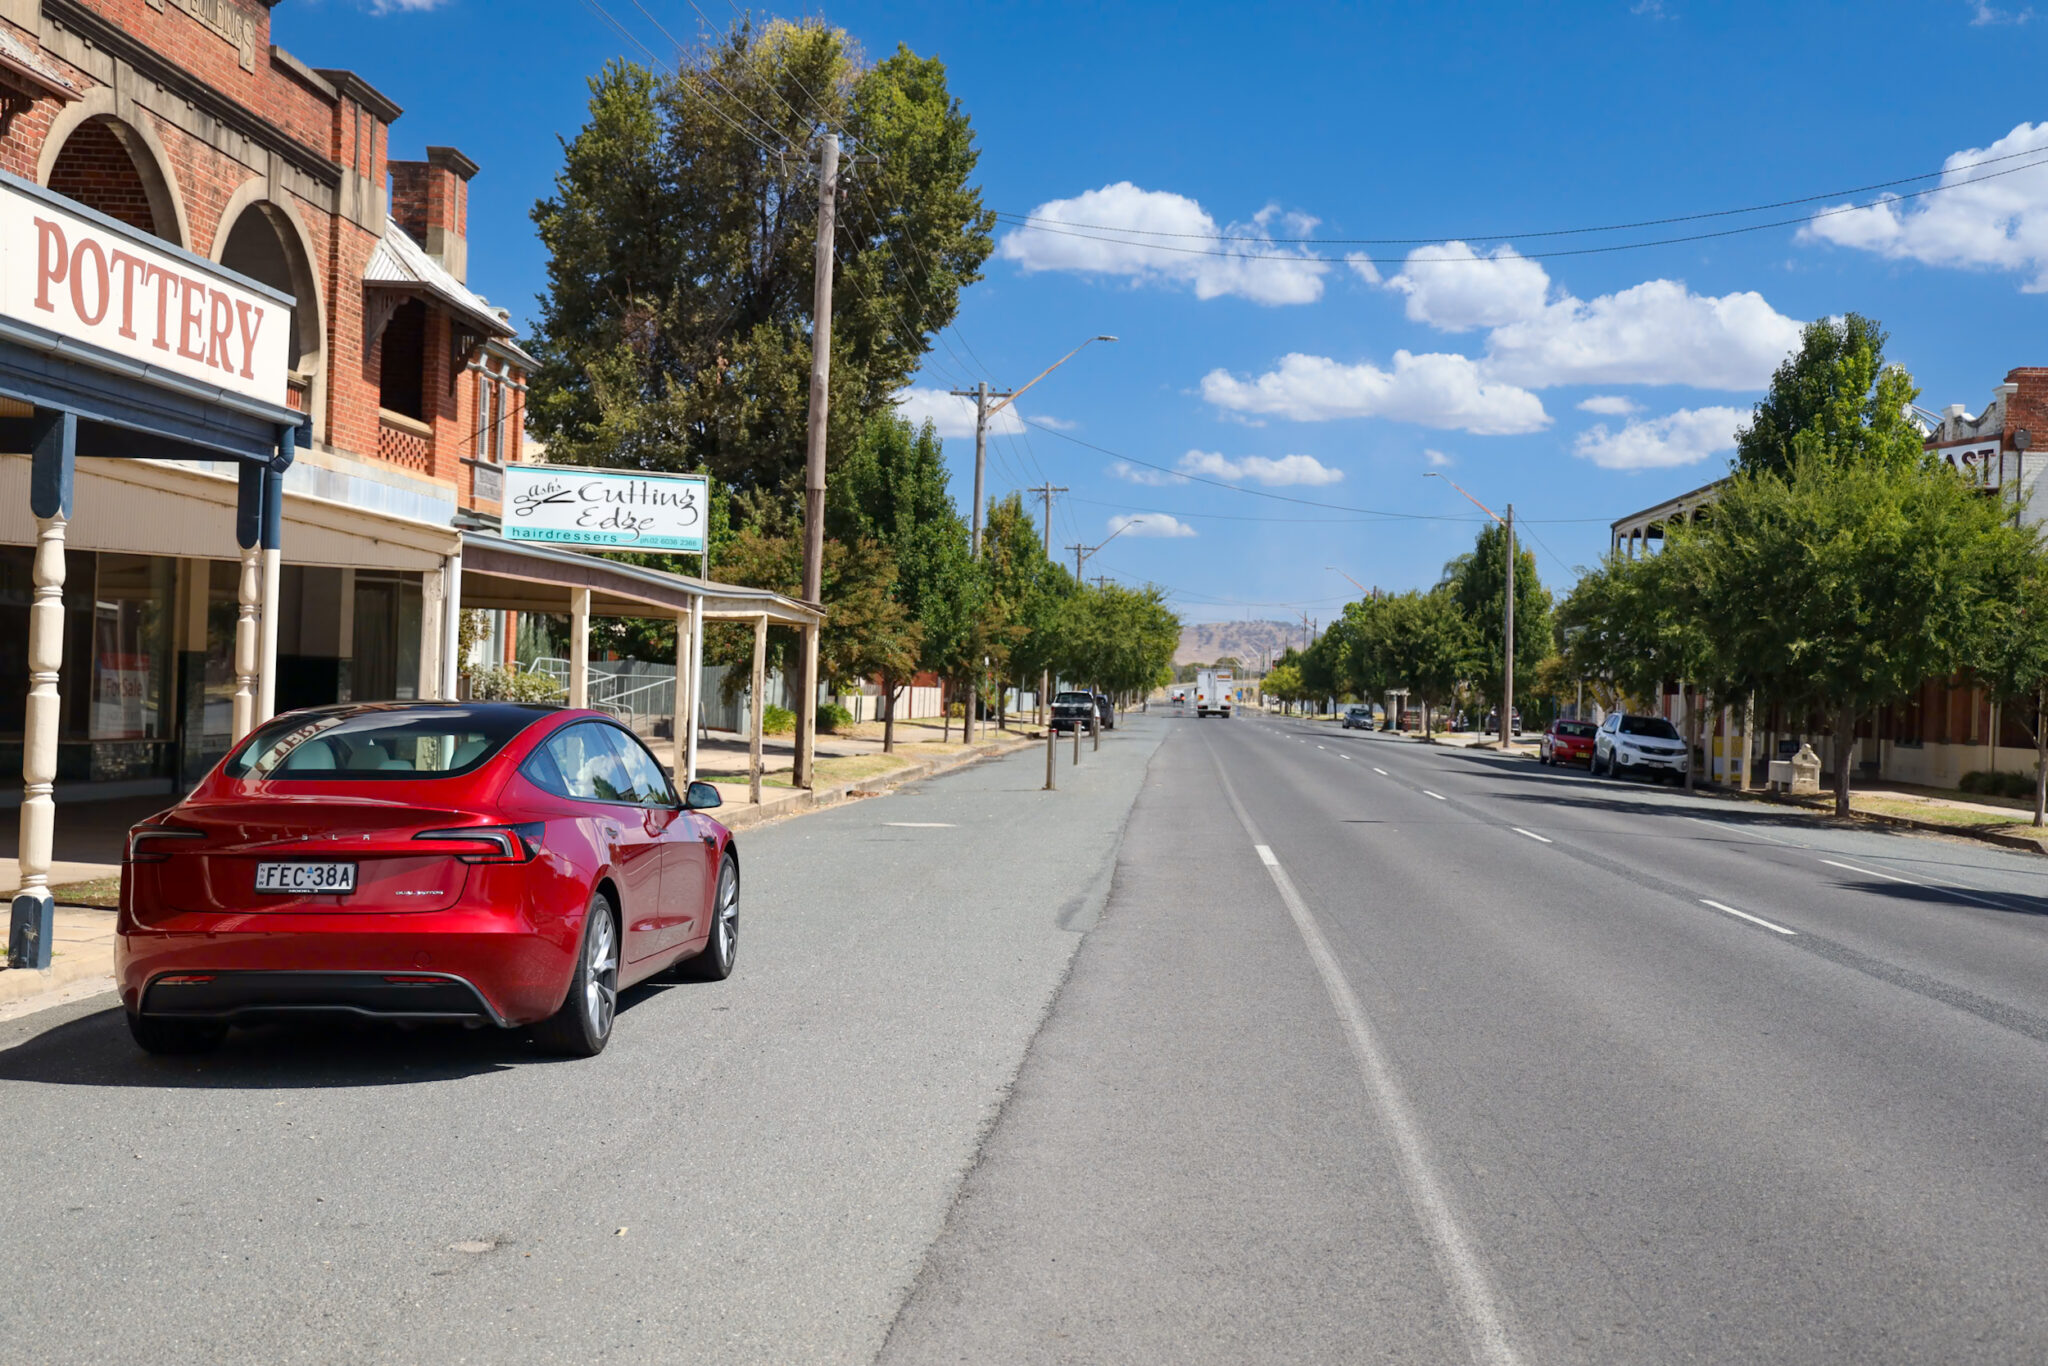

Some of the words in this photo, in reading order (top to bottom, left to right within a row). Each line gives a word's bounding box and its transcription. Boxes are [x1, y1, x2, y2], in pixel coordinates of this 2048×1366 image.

[33, 215, 264, 381] POTTERY
[577, 479, 698, 526] Cutting
[512, 527, 618, 543] hairdressers
[575, 506, 656, 542] Edge
[105, 678, 120, 697] For
[122, 678, 142, 697] Sale
